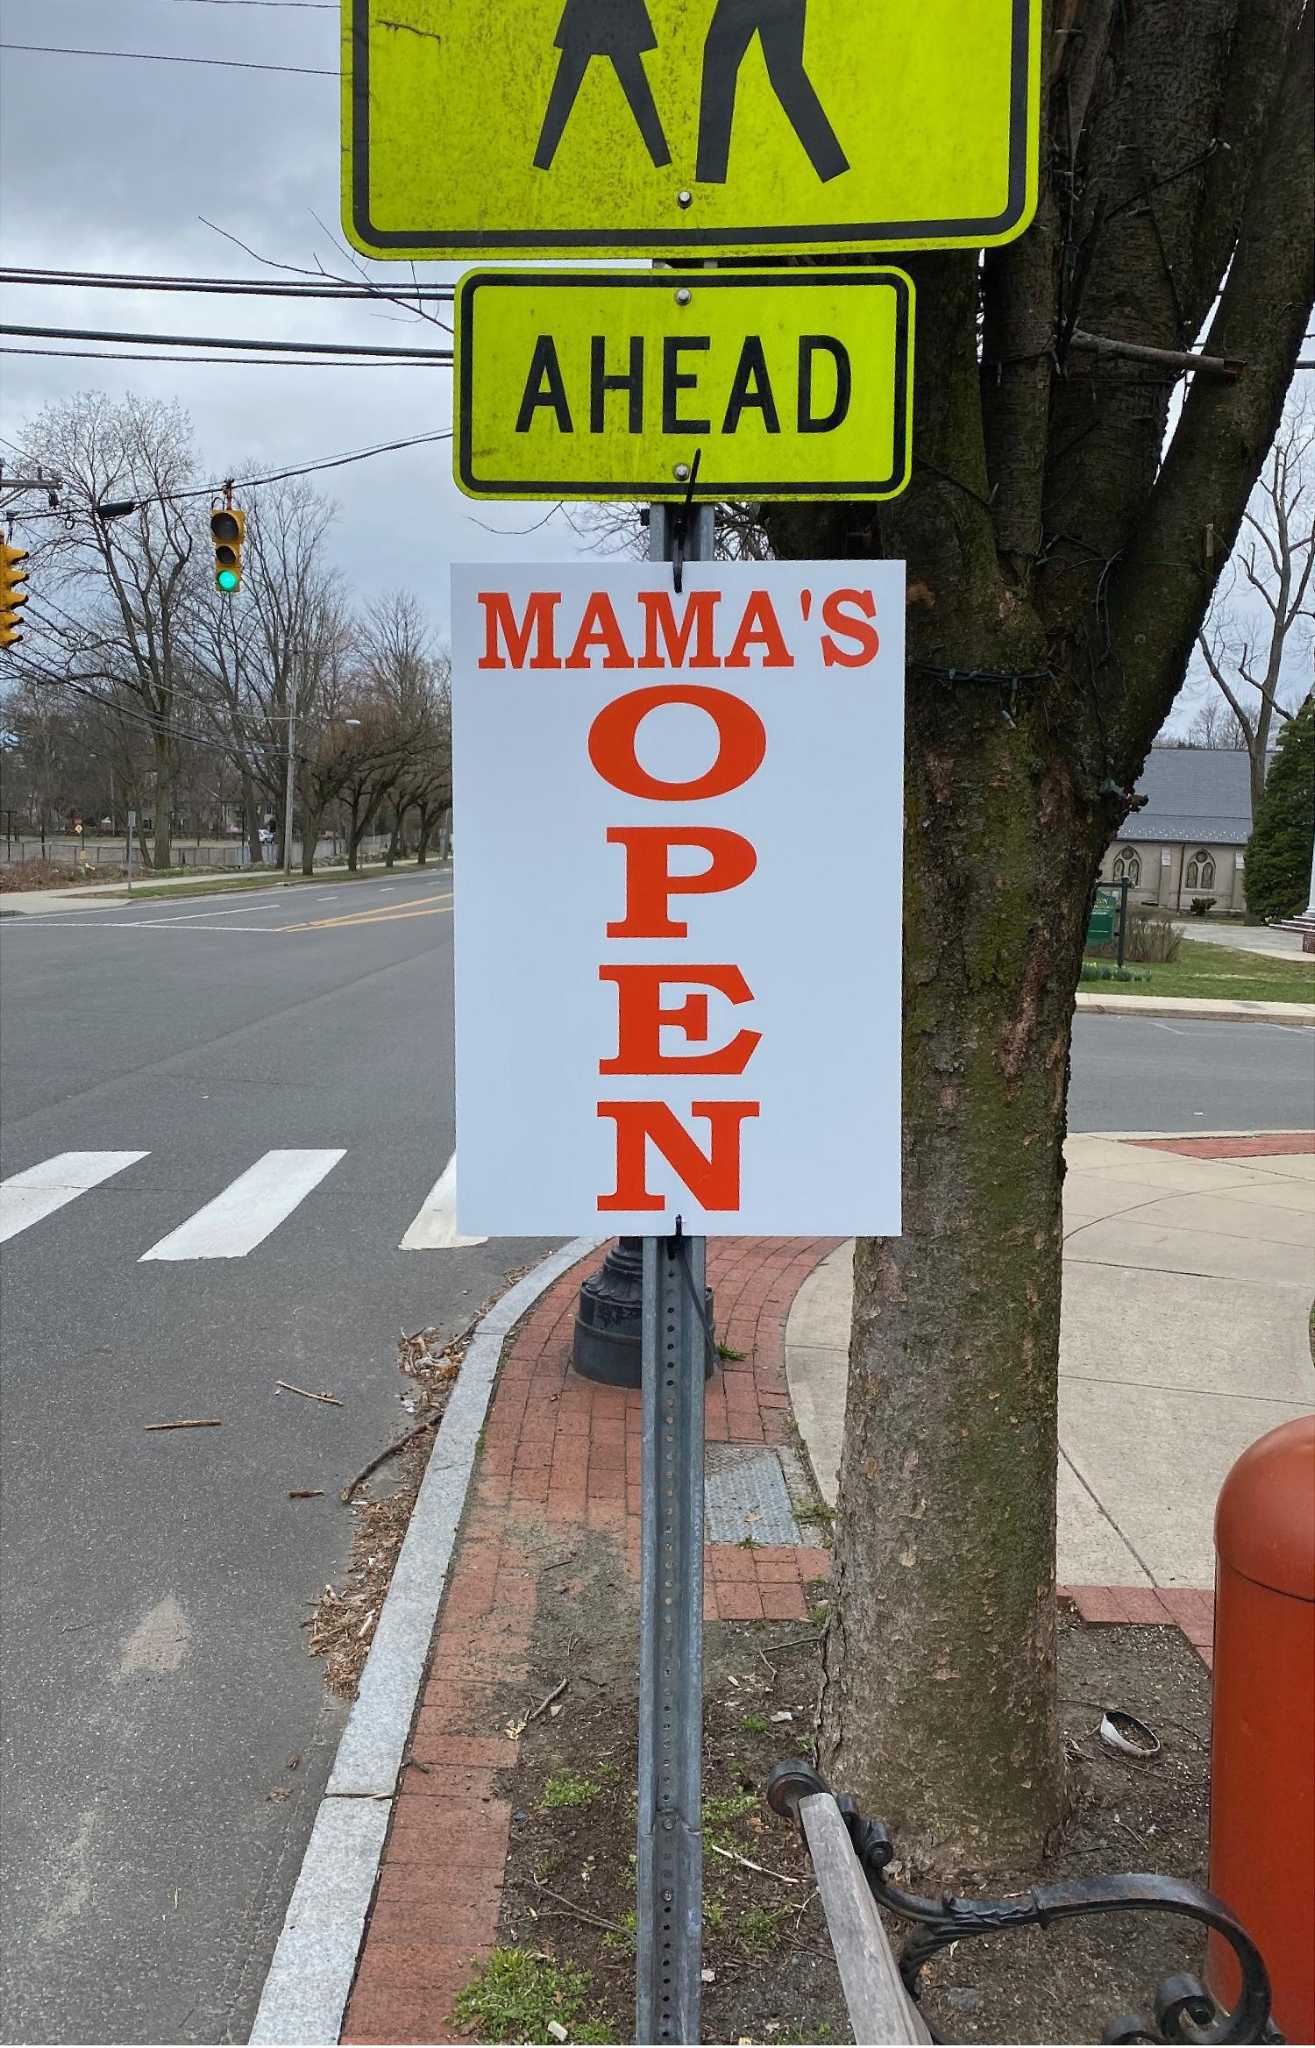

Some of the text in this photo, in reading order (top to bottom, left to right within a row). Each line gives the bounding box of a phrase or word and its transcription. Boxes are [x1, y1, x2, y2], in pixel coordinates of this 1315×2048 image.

[515, 335, 852, 434] AHEAD
[478, 589, 880, 670] MAMA'S
[588, 685, 765, 1212] OPEN
